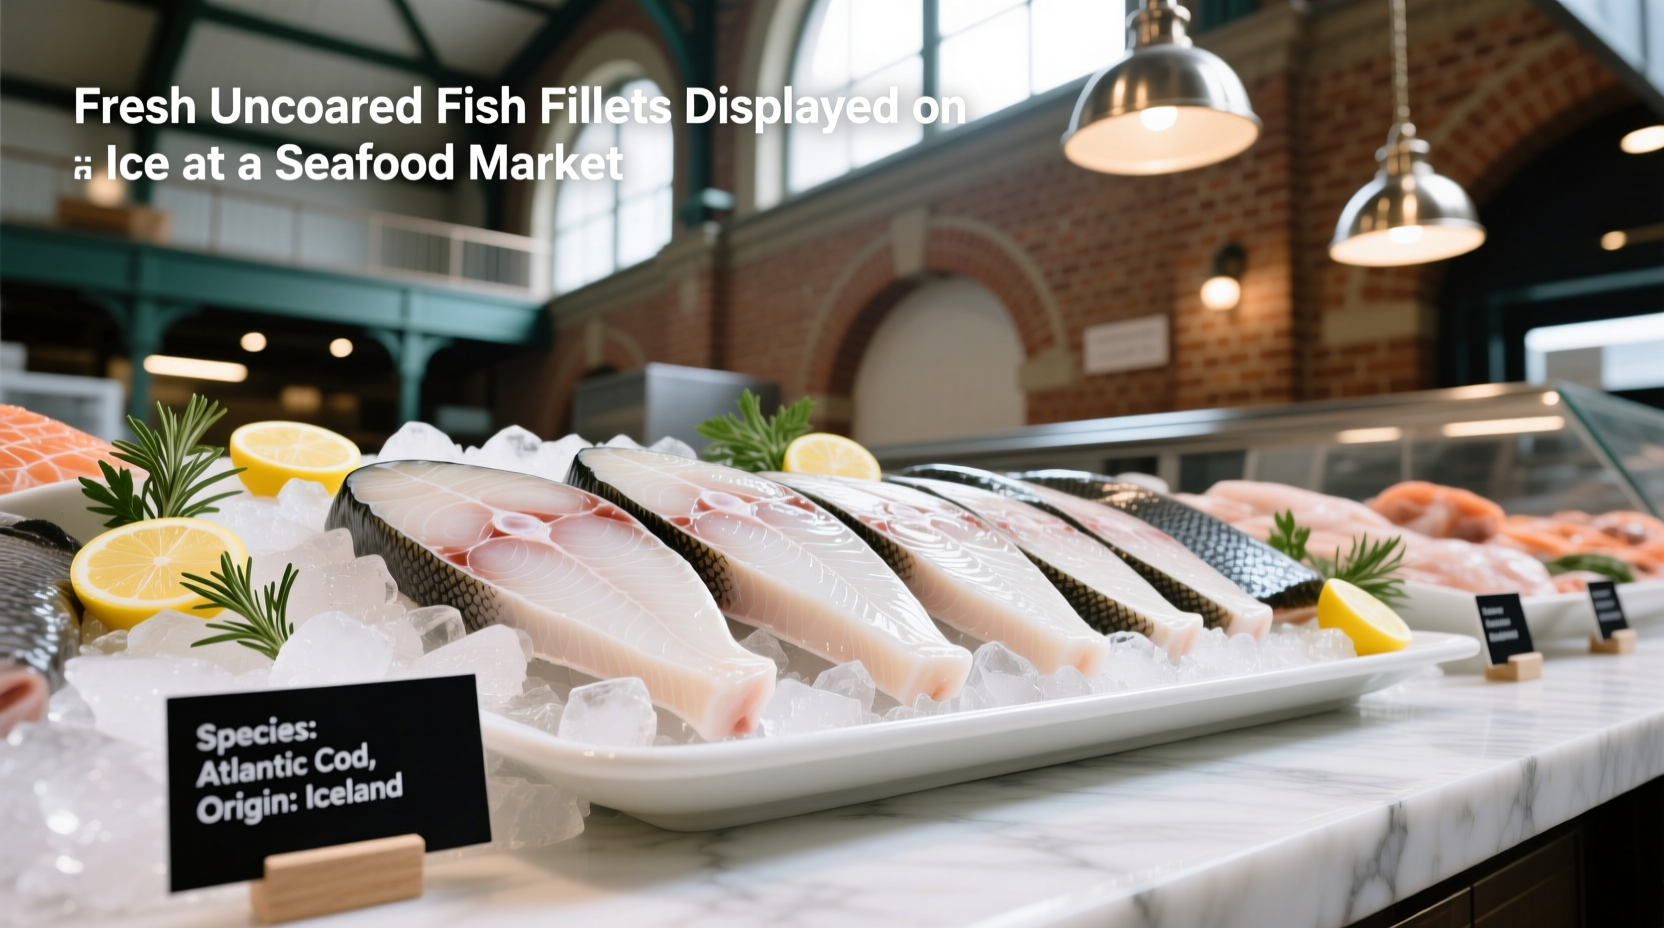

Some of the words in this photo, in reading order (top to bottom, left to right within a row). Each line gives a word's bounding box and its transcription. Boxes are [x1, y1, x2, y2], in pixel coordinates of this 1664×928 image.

[196, 717, 317, 756] Species:
[196, 751, 308, 788] Atlantic
[315, 742, 376, 773] Cod,
[196, 788, 298, 826] Origin:
[306, 772, 403, 809] Iceland
